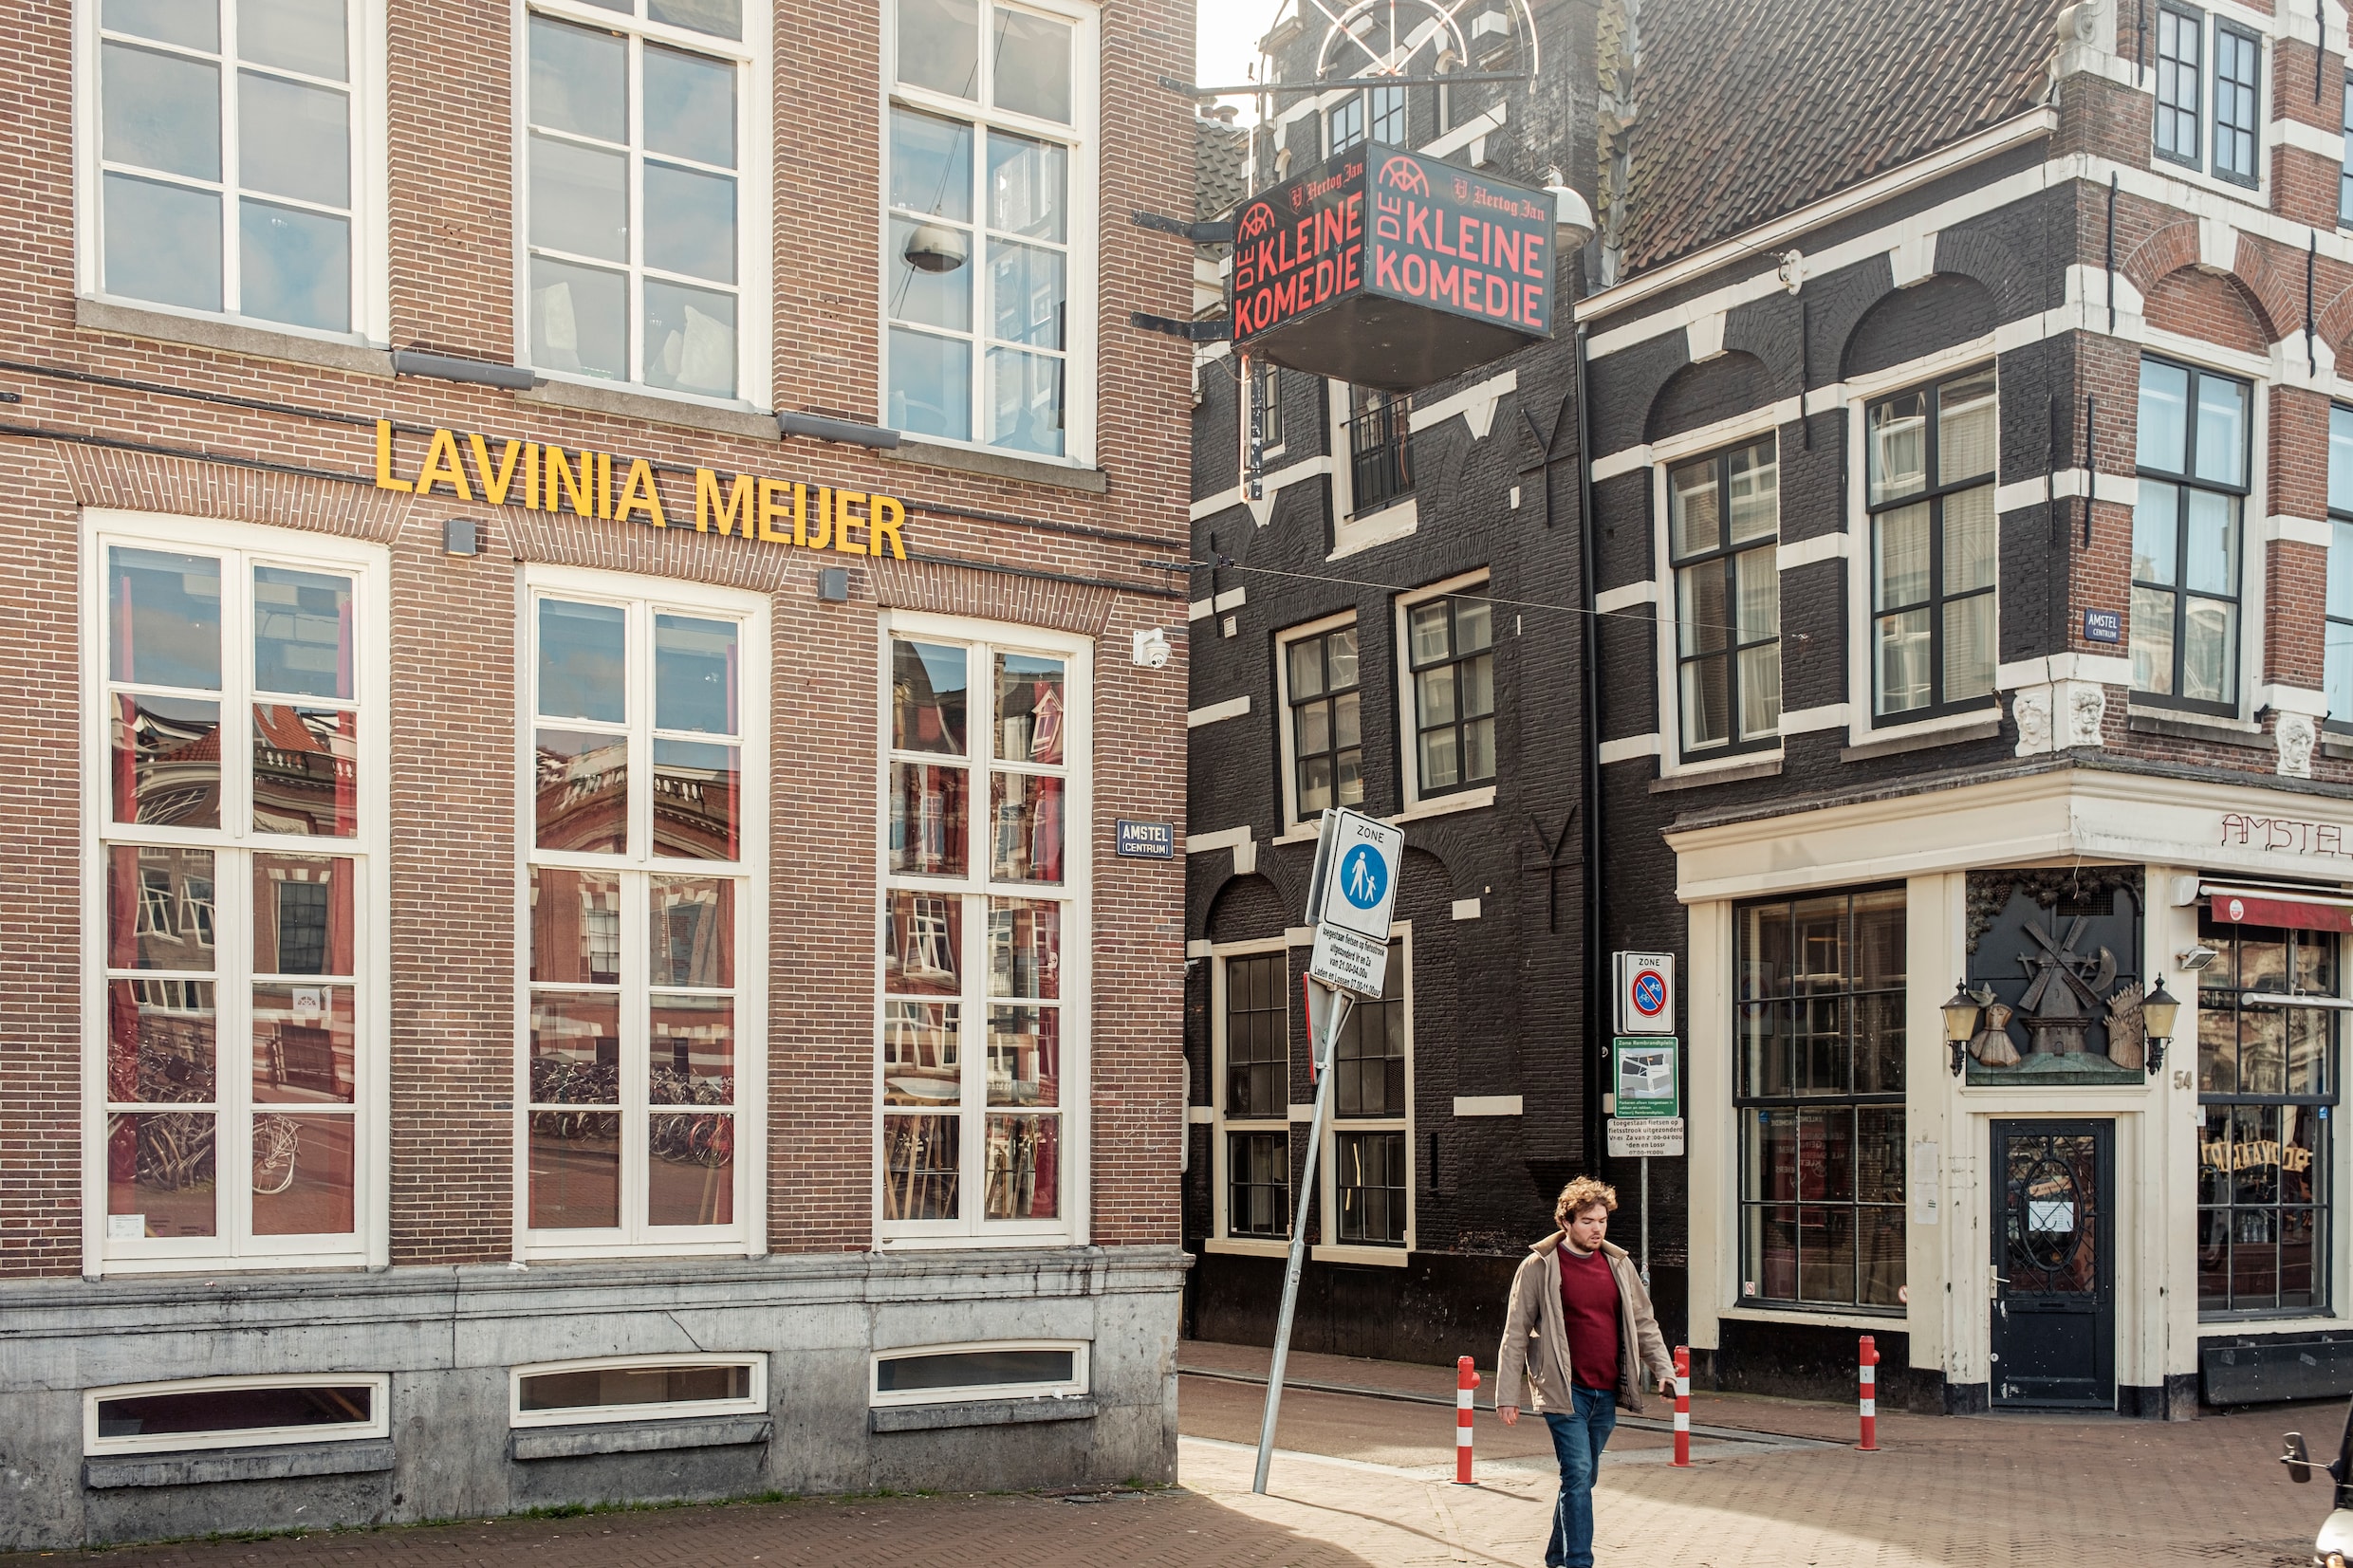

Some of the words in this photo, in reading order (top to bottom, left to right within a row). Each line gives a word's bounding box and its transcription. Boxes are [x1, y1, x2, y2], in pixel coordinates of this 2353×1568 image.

[1306, 173, 1343, 206] Hertog
[1343, 162, 1363, 188] Jan
[1473, 185, 1518, 217] Hertog
[1519, 199, 1546, 221] Jan
[1236, 245, 1255, 291] DE
[1258, 191, 1362, 283] KLEINE
[1378, 192, 1401, 241] DE
[1406, 200, 1544, 279] KLEINE
[1234, 244, 1362, 340] KOMEDIE
[1377, 244, 1543, 328] KOMEDIE
[376, 418, 667, 527] LAVINIA
[695, 468, 907, 561] MEIJER
[2088, 614, 2117, 628] AMSTEL
[2093, 628, 2116, 638] CENTRUM
[1122, 824, 1169, 842] AMSTEL
[1357, 824, 1385, 843] ZONE
[2222, 813, 2353, 859] AMSTEL
[1122, 841, 1169, 855] (CENTRUM)
[1329, 957, 1339, 968] van
[1639, 958, 1660, 967] ZONE
[1314, 965, 1328, 980] Laden
[1334, 973, 1350, 987] Lossen
[2173, 1070, 2194, 1091] 54
